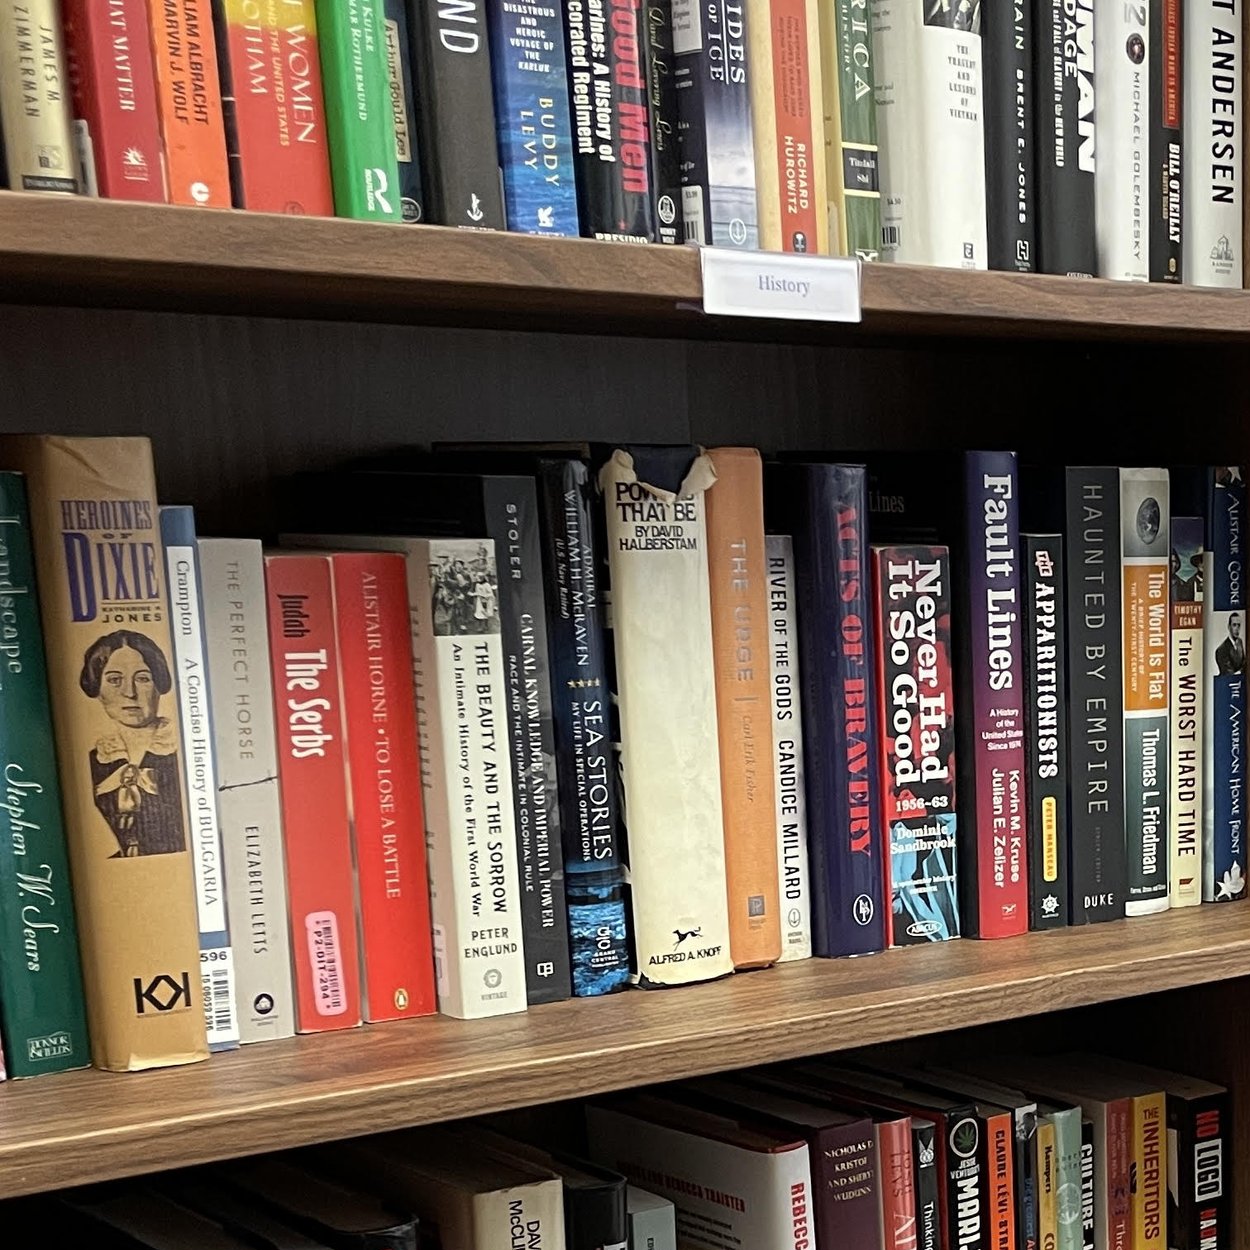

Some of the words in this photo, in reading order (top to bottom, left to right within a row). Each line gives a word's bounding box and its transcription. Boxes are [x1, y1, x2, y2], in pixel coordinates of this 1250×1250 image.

[286, 24, 316, 143] WOMEN
[1210, 26, 1235, 204] ANDERSEN
[520, 111, 538, 170] LEVY
[539, 97, 559, 187] BUDDY
[1169, 143, 1180, 169] BILL
[785, 135, 797, 215] HUROWITZ
[795, 142, 809, 211] RICHARD
[1169, 171, 1180, 244] O'REILLY
[758, 273, 811, 298] History
[61, 501, 153, 530] HEROINES
[102, 532, 132, 541] OF
[506, 503, 520, 580] STOLER
[982, 473, 1013, 579] Fault
[62, 533, 160, 623] DIXIE
[226, 562, 239, 594] THE
[837, 505, 859, 602] ACTS
[887, 562, 909, 598] It
[1082, 485, 1104, 629] HAUNTED
[1146, 571, 1165, 599] The
[228, 601, 248, 688] PERFECT
[277, 592, 310, 638] Judah
[840, 615, 864, 665] OF
[888, 608, 914, 665] So
[914, 561, 940, 687] Never
[986, 588, 1016, 691] Lines
[1147, 600, 1164, 647] World
[284, 648, 327, 692] The
[475, 641, 490, 675] THE
[1035, 581, 1058, 779] APPARITIONISTS
[1085, 644, 1105, 681] BY
[1148, 654, 1163, 668] Is
[1176, 637, 1191, 669] The
[476, 683, 497, 754] BEAUTY
[1148, 672, 1163, 700] Flat
[1177, 671, 1196, 742] WORST
[235, 694, 253, 761] HORSE
[289, 698, 332, 758] Serbs
[583, 700, 603, 747] SEA
[891, 677, 920, 787] Good
[918, 692, 948, 783] Had
[482, 761, 500, 793] AND
[779, 740, 797, 815] CANDICE
[842, 679, 871, 856] BRAVERY
[1087, 698, 1109, 815] EMPIRE
[1178, 744, 1196, 804] HARD
[486, 801, 501, 835] THE
[586, 754, 613, 861] STORIES
[1178, 803, 1195, 856] TIME
[244, 825, 263, 908] ELIZABETH
[487, 842, 507, 914] SORROW
[783, 819, 800, 900] MILLARD
[1083, 893, 1114, 908] DUKE
[250, 913, 267, 955] LETTS
[1143, 1109, 1159, 1119] THE
[1143, 1121, 1161, 1241] INHERITORS
[1194, 1139, 1222, 1202] LOGO
